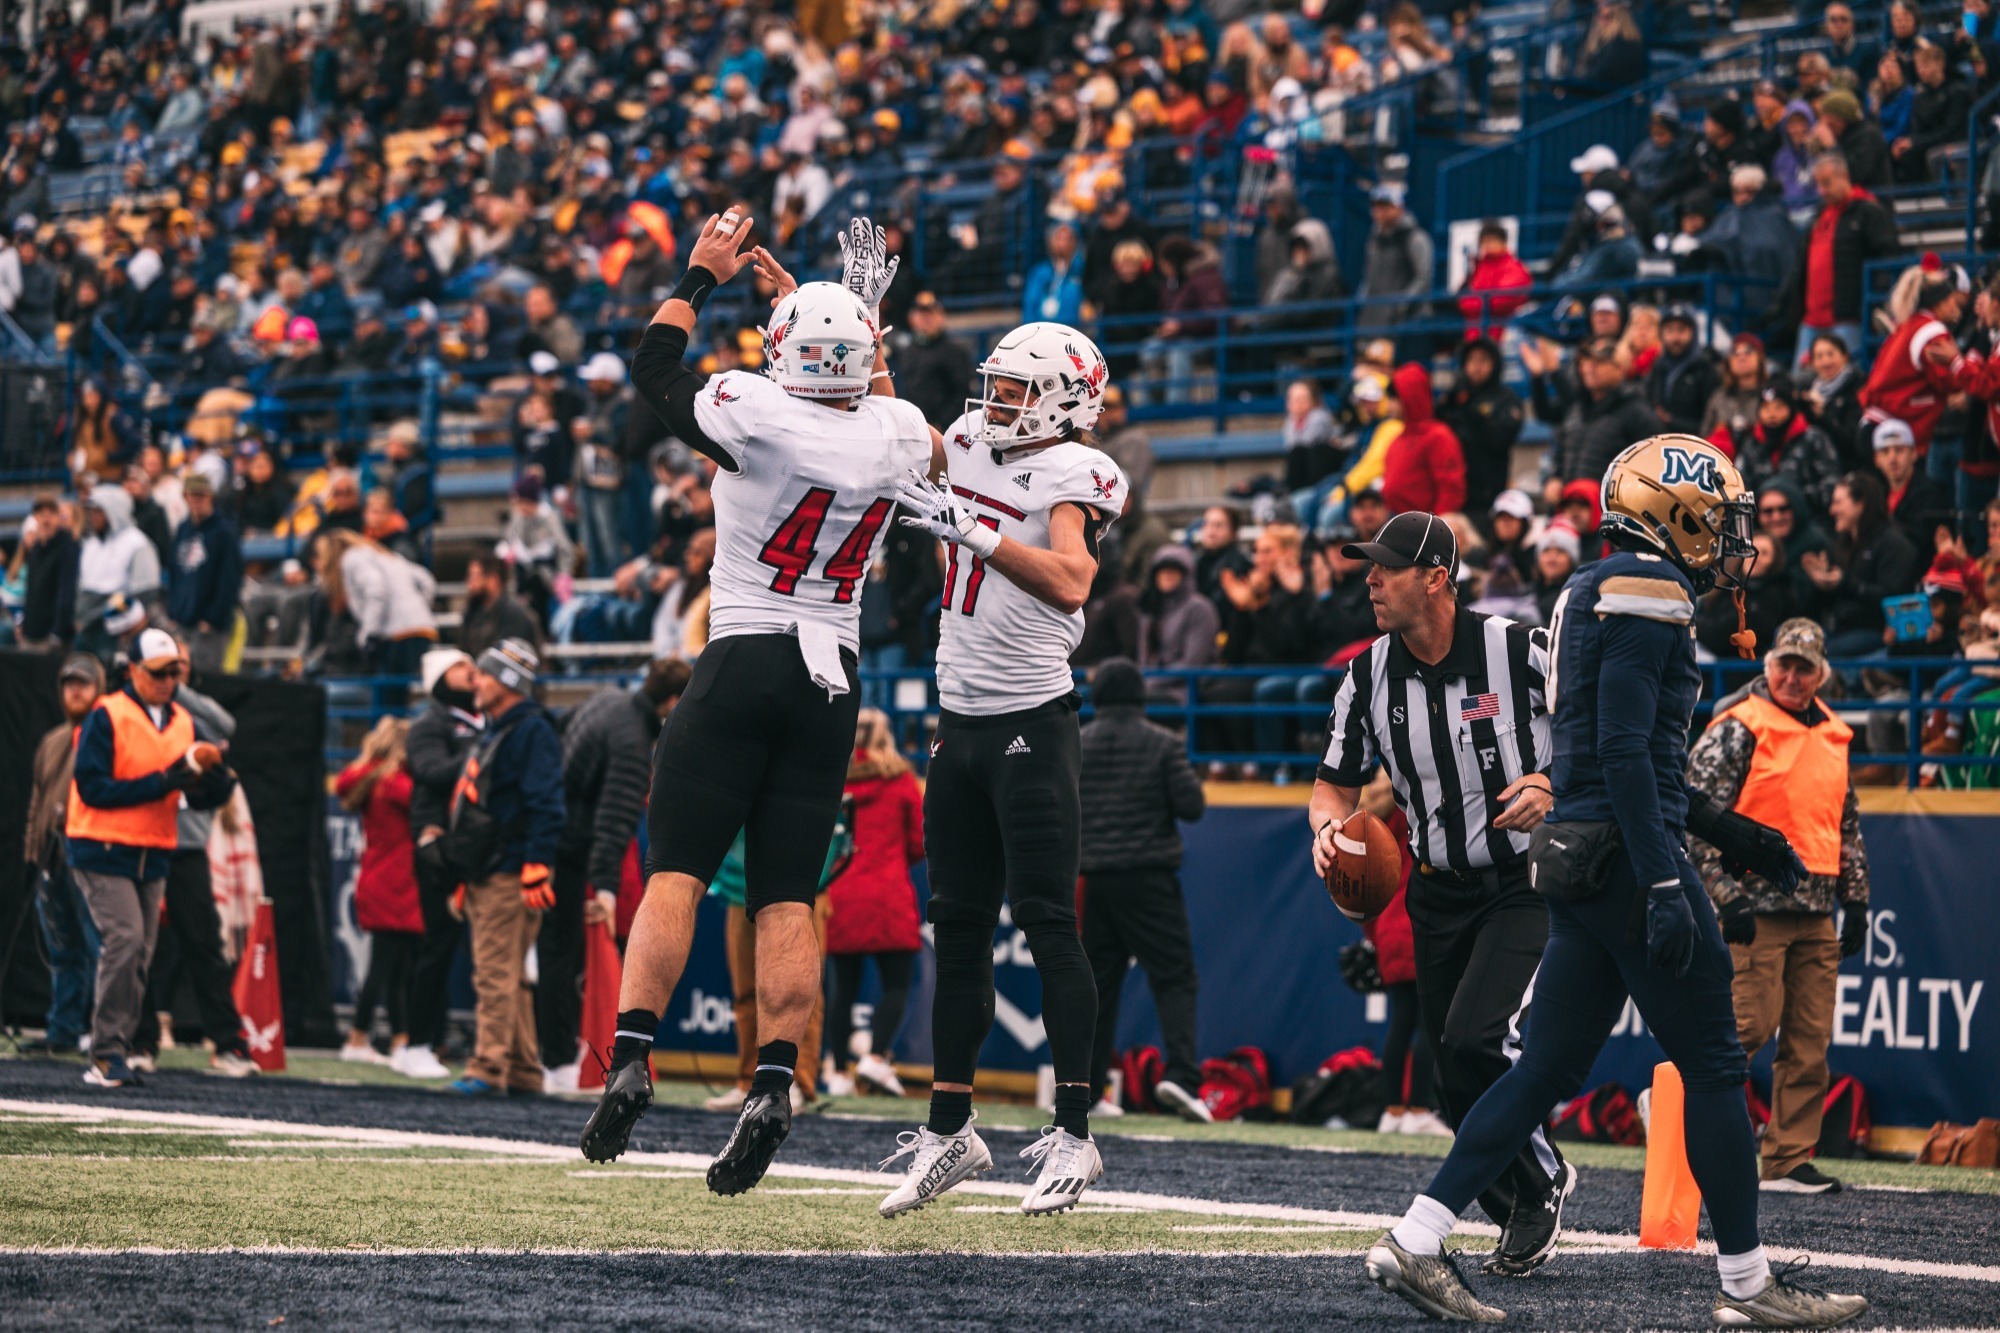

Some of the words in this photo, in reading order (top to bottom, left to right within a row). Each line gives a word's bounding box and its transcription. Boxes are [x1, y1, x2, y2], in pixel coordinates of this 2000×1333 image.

[831, 363, 847, 376] 44
[783, 385, 816, 394] EASTERN
[818, 386, 866, 395] WASHINGTON
[1659, 446, 1717, 495] M
[758, 487, 898, 604] 44
[1392, 706, 1405, 725] S
[1005, 745, 1031, 755] adidas
[1479, 747, 1496, 771] F
[1833, 974, 1985, 1053] EALTY
[916, 1139, 969, 1199] ADIZERO
